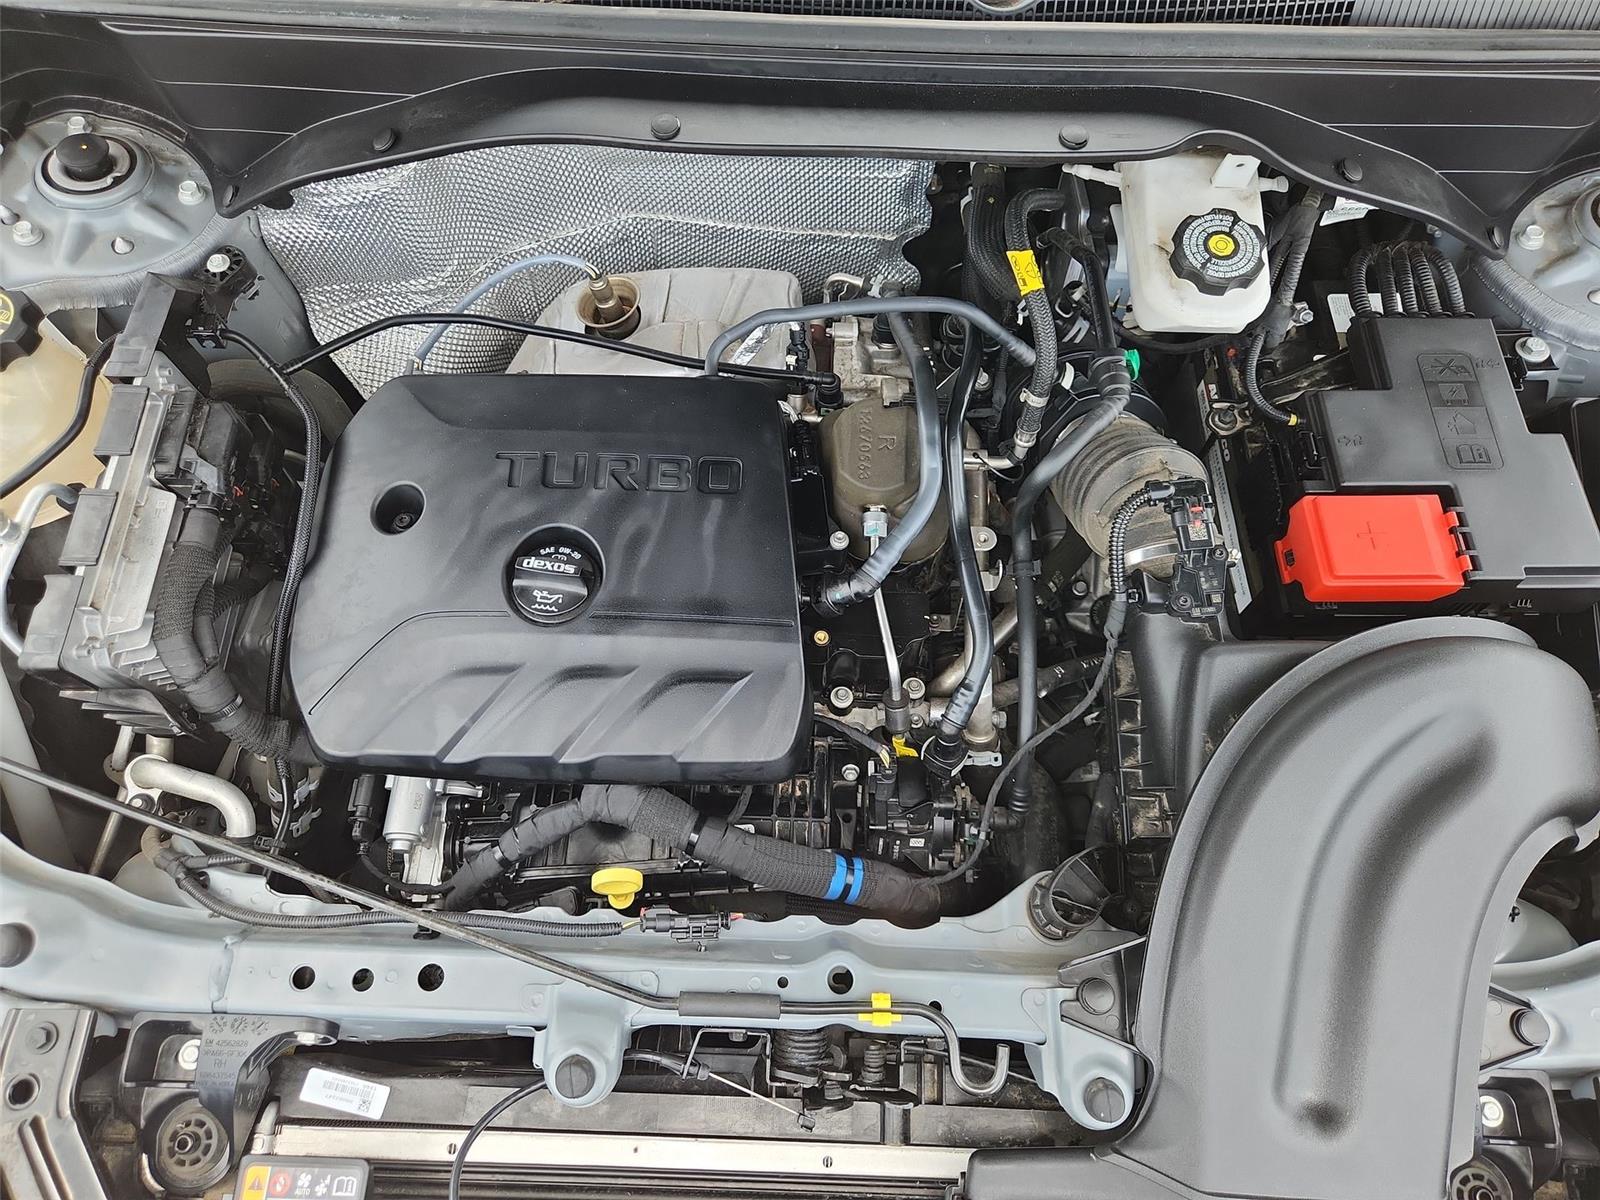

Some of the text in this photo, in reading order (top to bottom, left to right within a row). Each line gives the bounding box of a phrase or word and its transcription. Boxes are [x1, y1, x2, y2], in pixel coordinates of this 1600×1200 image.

[878, 435, 897, 452] R
[495, 451, 743, 494] TURBO
[540, 546, 556, 555] SAE
[522, 556, 578, 574] dexos
[213, 1058, 227, 1069] RH
